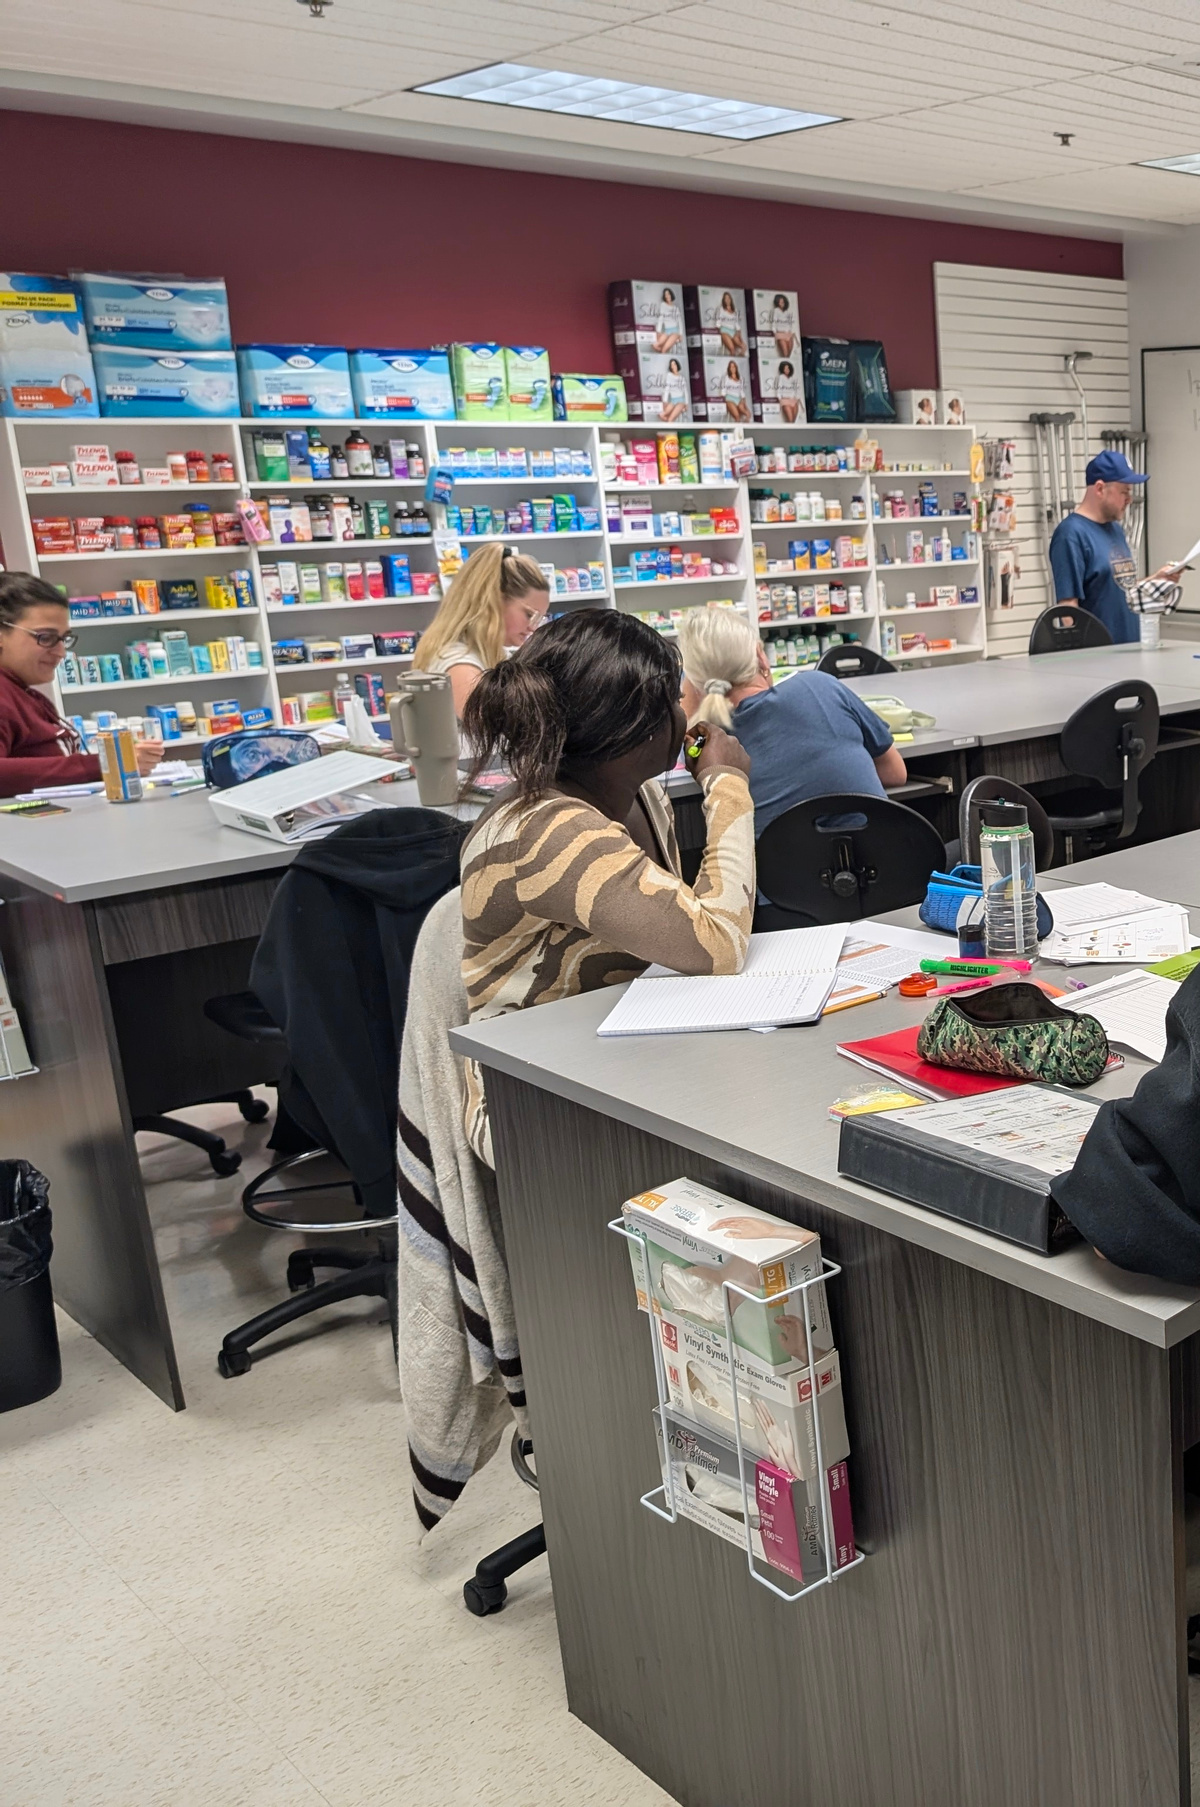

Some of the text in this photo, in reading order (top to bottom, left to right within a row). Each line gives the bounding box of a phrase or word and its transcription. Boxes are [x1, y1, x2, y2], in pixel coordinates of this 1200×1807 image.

[822, 359, 847, 368] MEN
[75, 463, 115, 473] TYLENOL
[80, 537, 113, 545] TYLENOL
[170, 584, 193, 594] Advil
[64, 658, 77, 684] Advil
[87, 660, 98, 683] Advil
[950, 964, 989, 974] HIGHLIGHTER
[671, 1204, 697, 1220] DEFENSE
[682, 1236, 699, 1252] Vinyl
[767, 1268, 776, 1284] TG
[682, 1319, 711, 1338] DEFENSE
[683, 1333, 787, 1391] Vinyl Synthtic Exam Gloves
[707, 1361, 723, 1373] Powder
[821, 1372, 832, 1386] M
[805, 1408, 817, 1471] Vinyl Synthetic
[694, 1445, 720, 1464] Premium
[689, 1451, 718, 1475] Ritmed
[758, 1471, 775, 1486] Vinyl
[758, 1480, 779, 1498] Vinyle
[760, 1509, 775, 1522] Small
[760, 1517, 773, 1529] Petit
[810, 1505, 818, 1530] Ritmed
[831, 1468, 847, 1565] Vinyl Small
[717, 1517, 738, 1534] Gloves
[763, 1529, 775, 1541] 100
[810, 1534, 819, 1556] AMD
